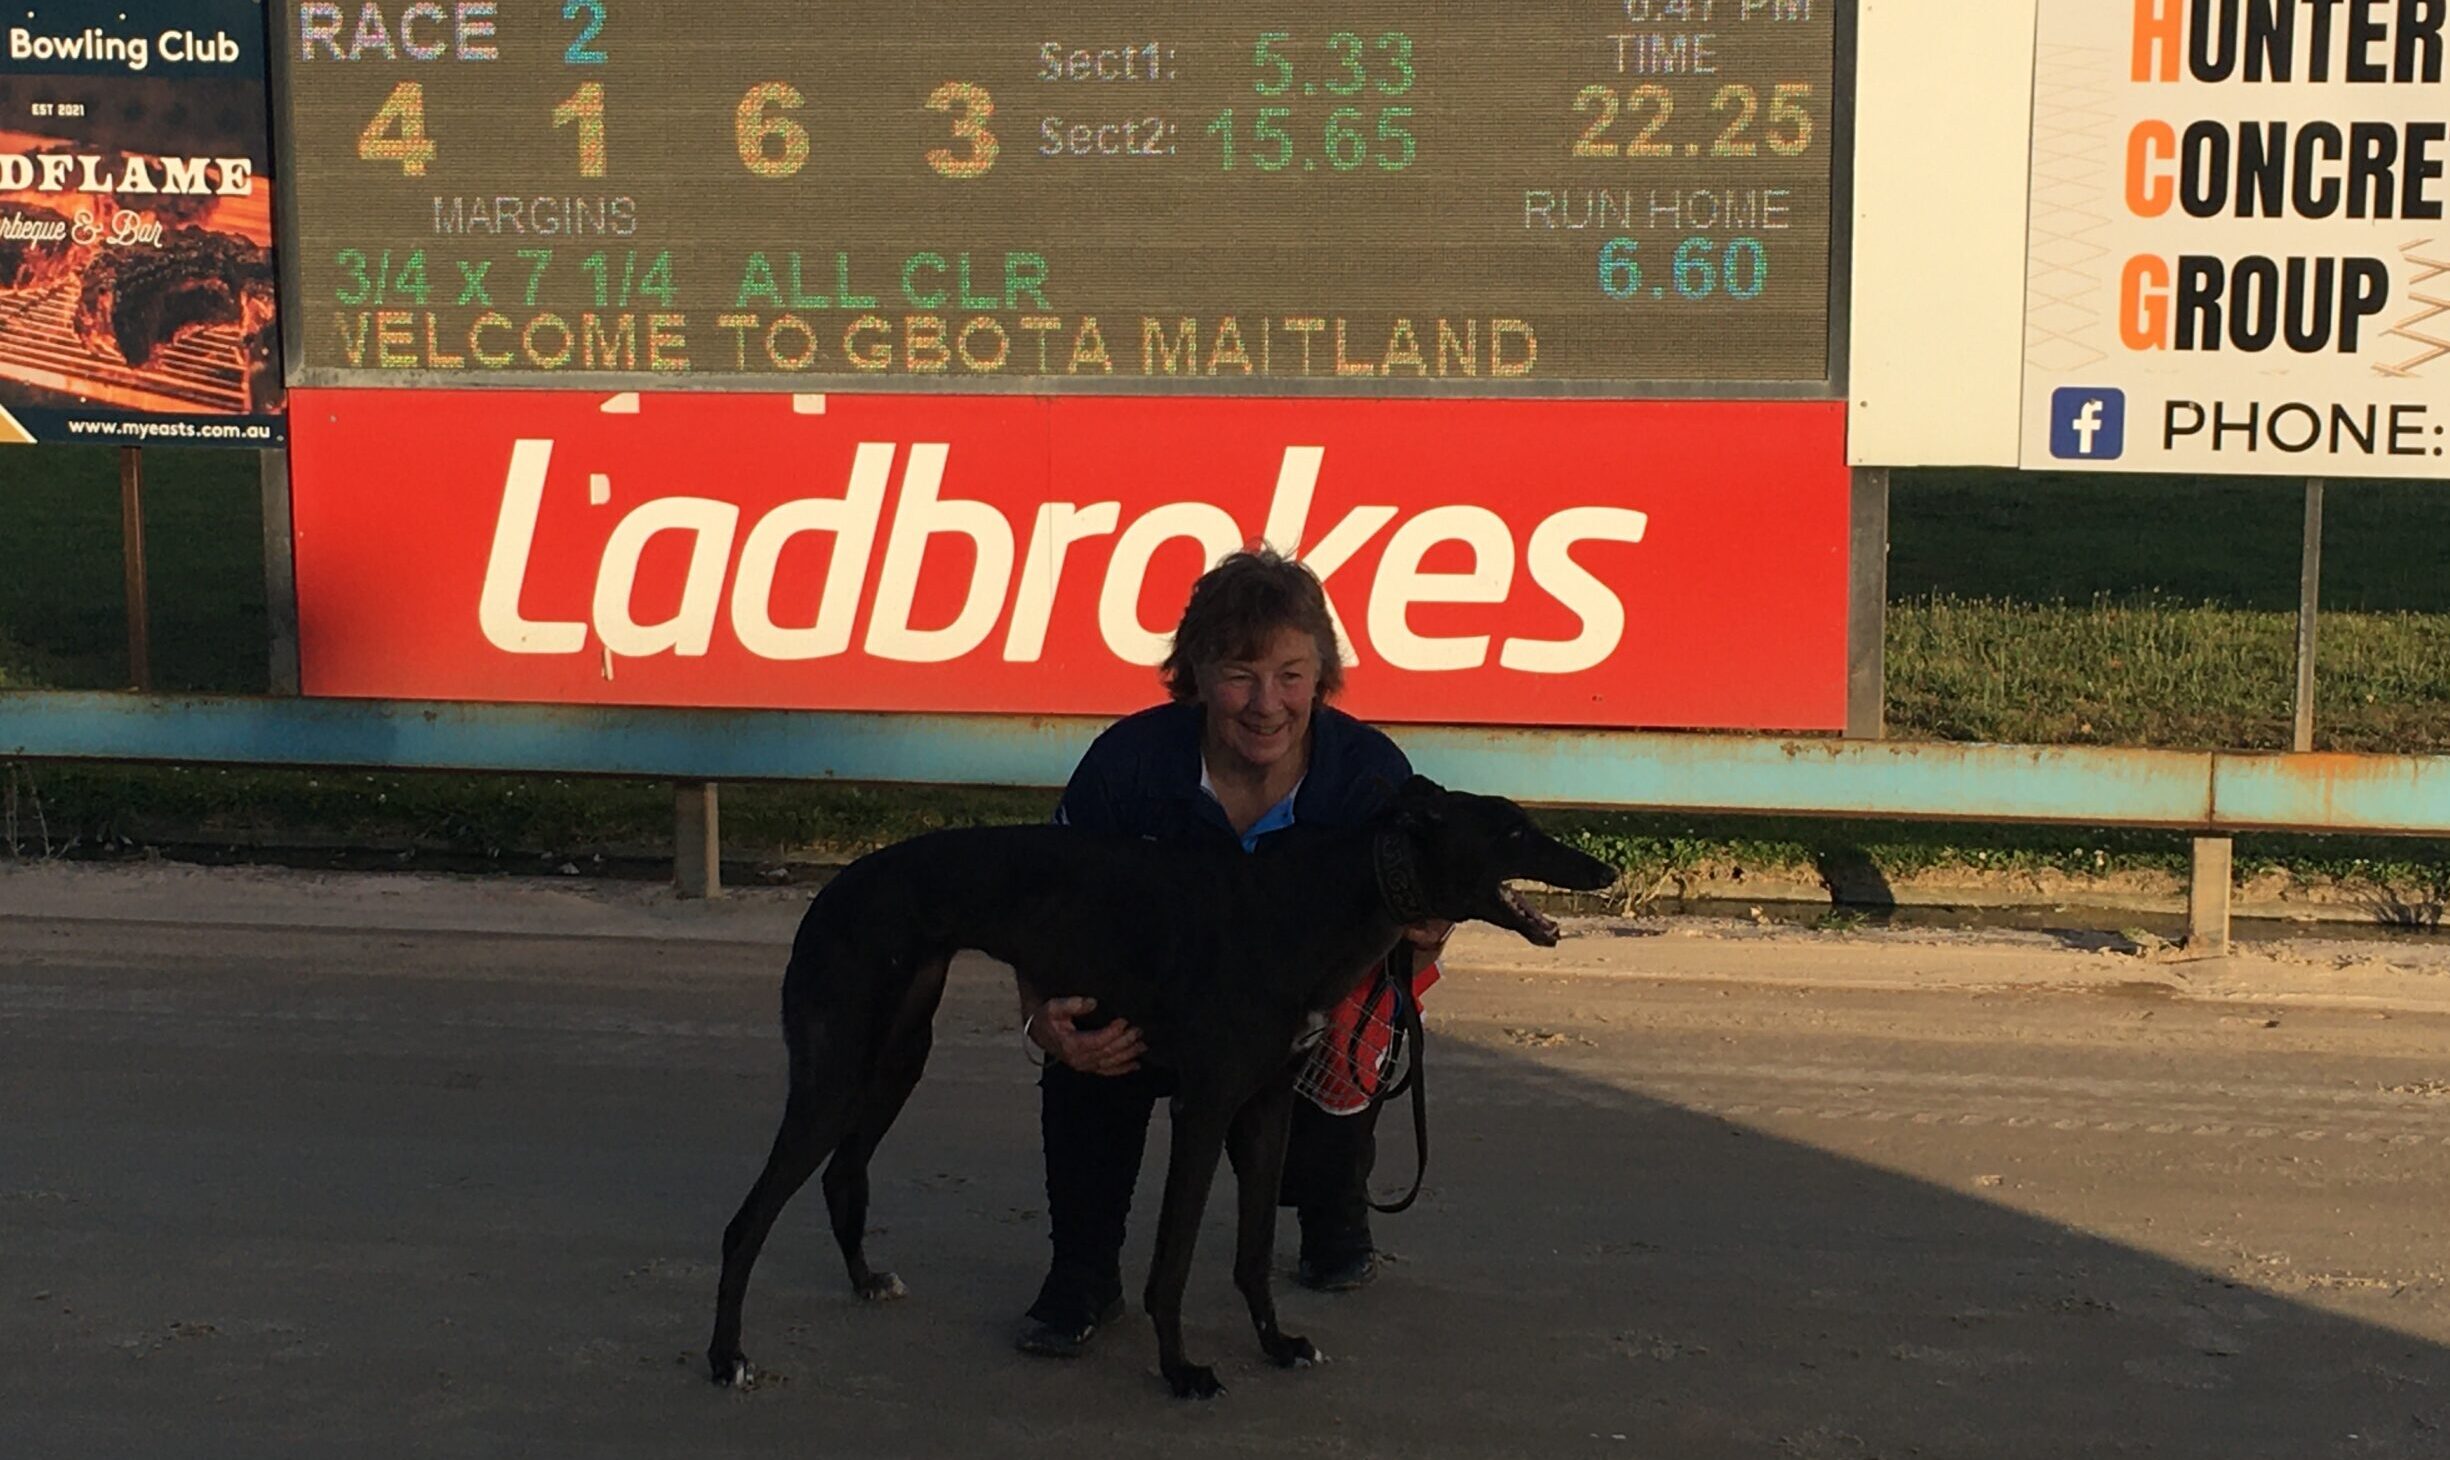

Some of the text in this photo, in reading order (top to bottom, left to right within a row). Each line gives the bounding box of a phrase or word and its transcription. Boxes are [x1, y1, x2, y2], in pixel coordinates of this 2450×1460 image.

[10, 28, 240, 70] Bowling Club
[301, 0, 608, 63] RACE 2
[1606, 33, 1718, 74] TIME
[2130, 0, 2447, 84] HUNTER
[1038, 31, 1417, 96] Sect1: 5.33
[31, 103, 85, 116] EST 2021
[358, 80, 1000, 178] 4 1 6 3
[1038, 106, 1417, 171] Sect2: 15.65
[1572, 83, 1813, 158] 22.25
[0, 153, 253, 197] DFLAME
[2124, 120, 2447, 220] CONCRE
[71, 209, 103, 245] &
[106, 209, 163, 248] Bar
[432, 196, 638, 235] MARGINS
[1525, 190, 1790, 231] RUN HOME
[335, 248, 679, 308] 3/4 x 7 1/4
[735, 250, 1053, 311] ALL CLR
[1596, 238, 1768, 300] 6.60
[2118, 252, 2390, 354] GROUP
[715, 312, 818, 371] TO
[843, 313, 1113, 375] GBOTA
[1143, 316, 1539, 378] MAITLAND
[69, 418, 271, 439] www.myeasts.com.au
[2163, 400, 2443, 457] PHONE:
[478, 438, 1649, 674] Ladbrokes
